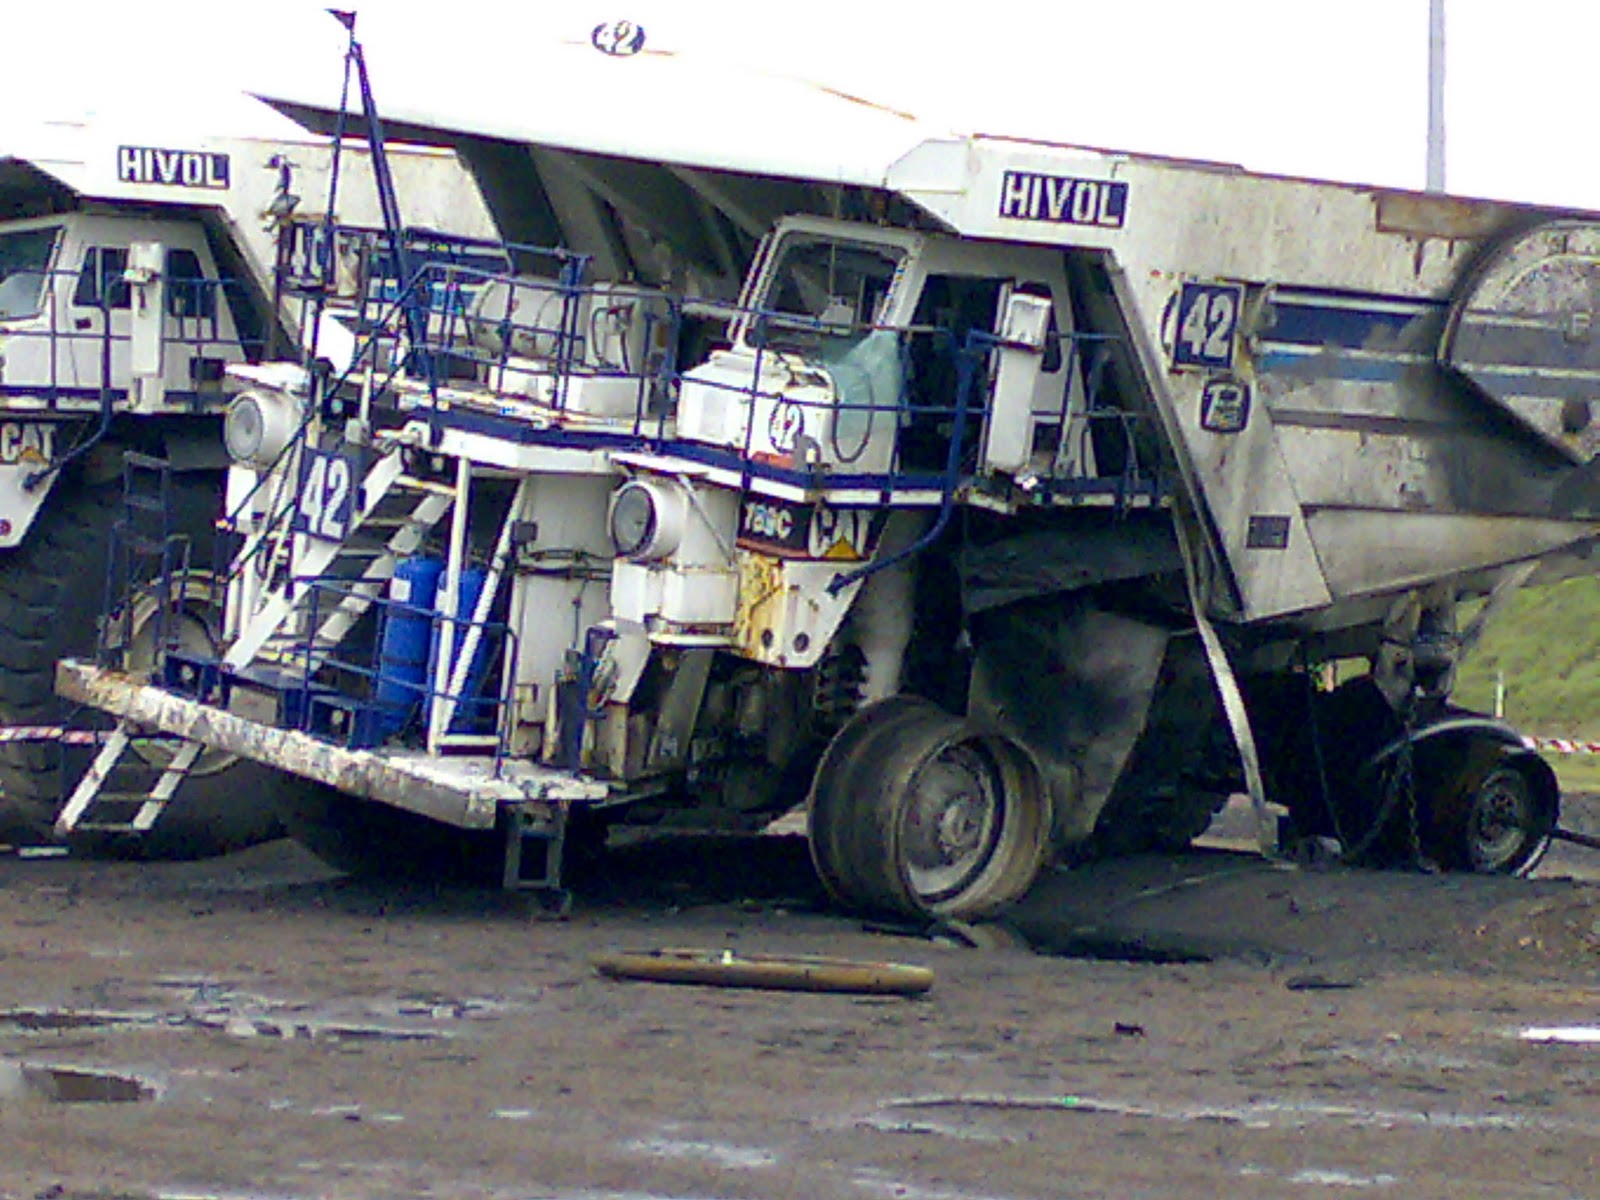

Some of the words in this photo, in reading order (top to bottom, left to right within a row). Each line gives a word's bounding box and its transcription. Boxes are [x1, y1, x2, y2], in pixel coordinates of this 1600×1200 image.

[121, 148, 227, 186] HIVOL
[1003, 173, 1120, 225] HIVOL
[1181, 292, 1234, 358] 42
[1, 422, 57, 462] CAT
[300, 455, 350, 540] 42
[808, 508, 872, 558] CAT
